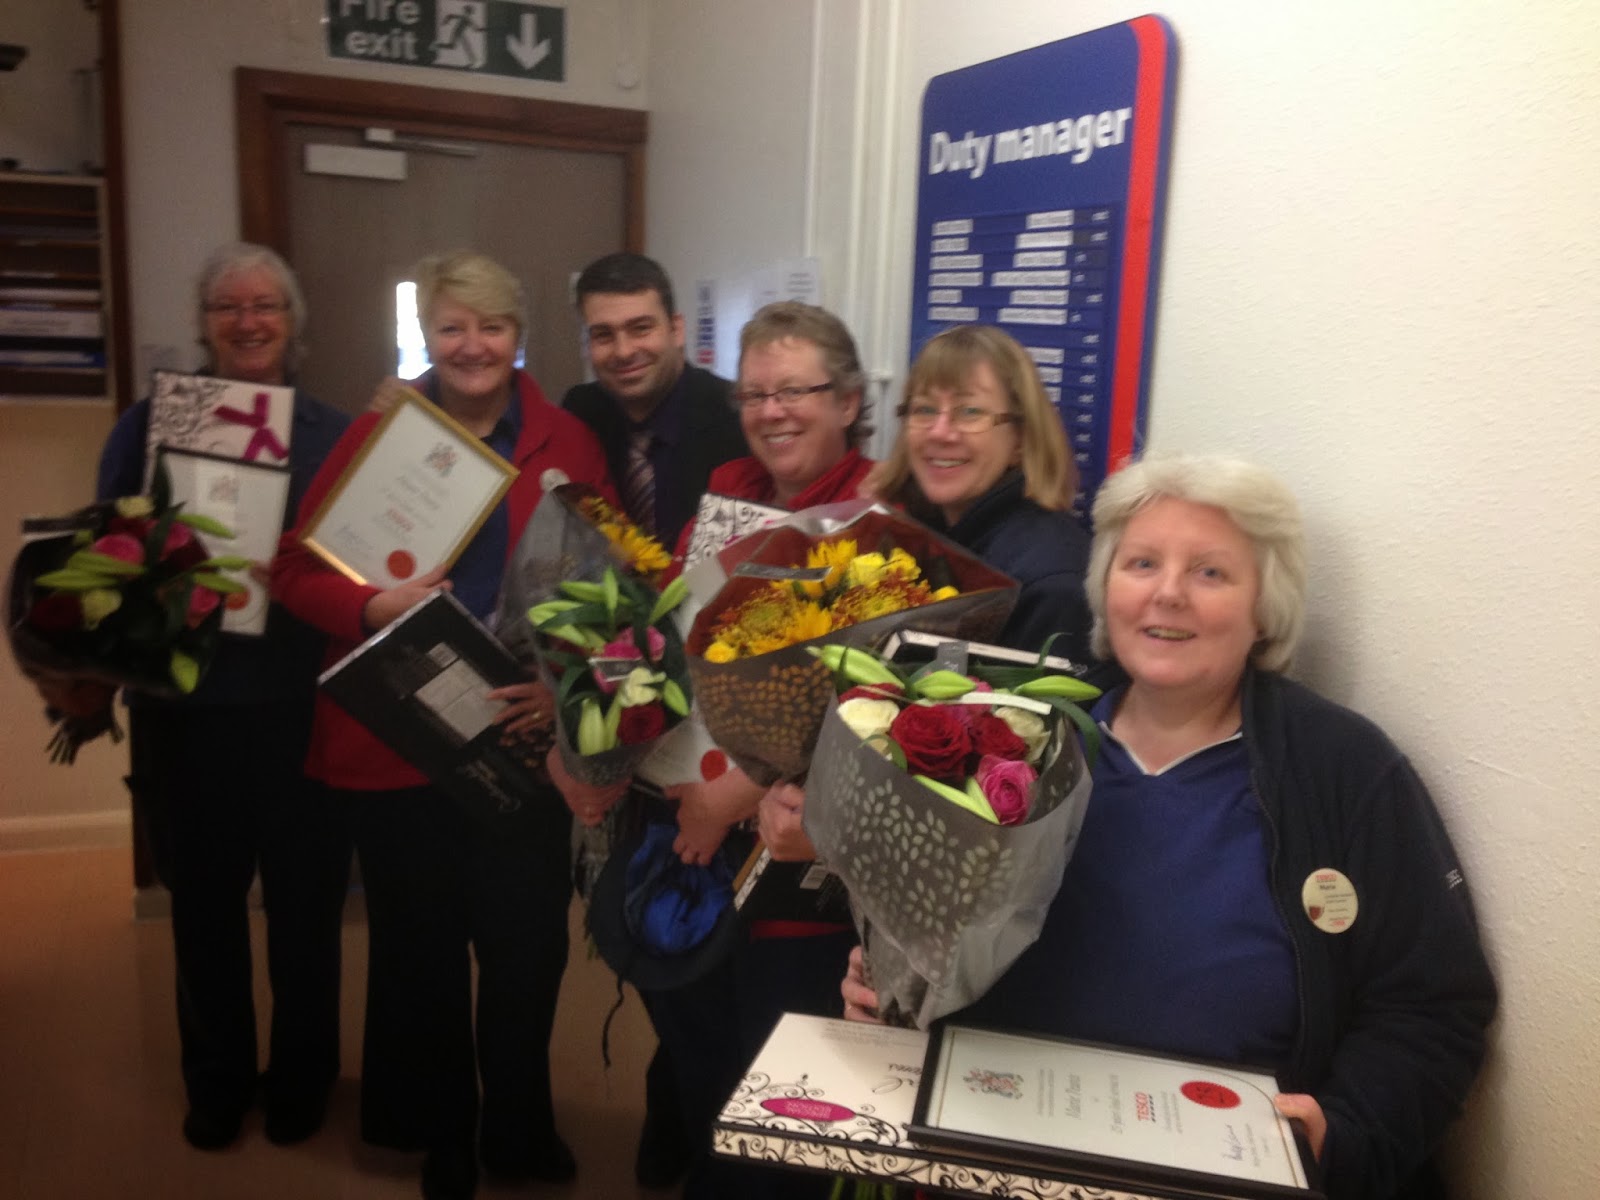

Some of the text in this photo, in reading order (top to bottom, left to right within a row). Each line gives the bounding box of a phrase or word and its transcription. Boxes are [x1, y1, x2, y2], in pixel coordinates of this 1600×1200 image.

[345, 27, 418, 60] exit
[928, 107, 1132, 179] Duty manager
[1135, 1091, 1149, 1121] TESCO
